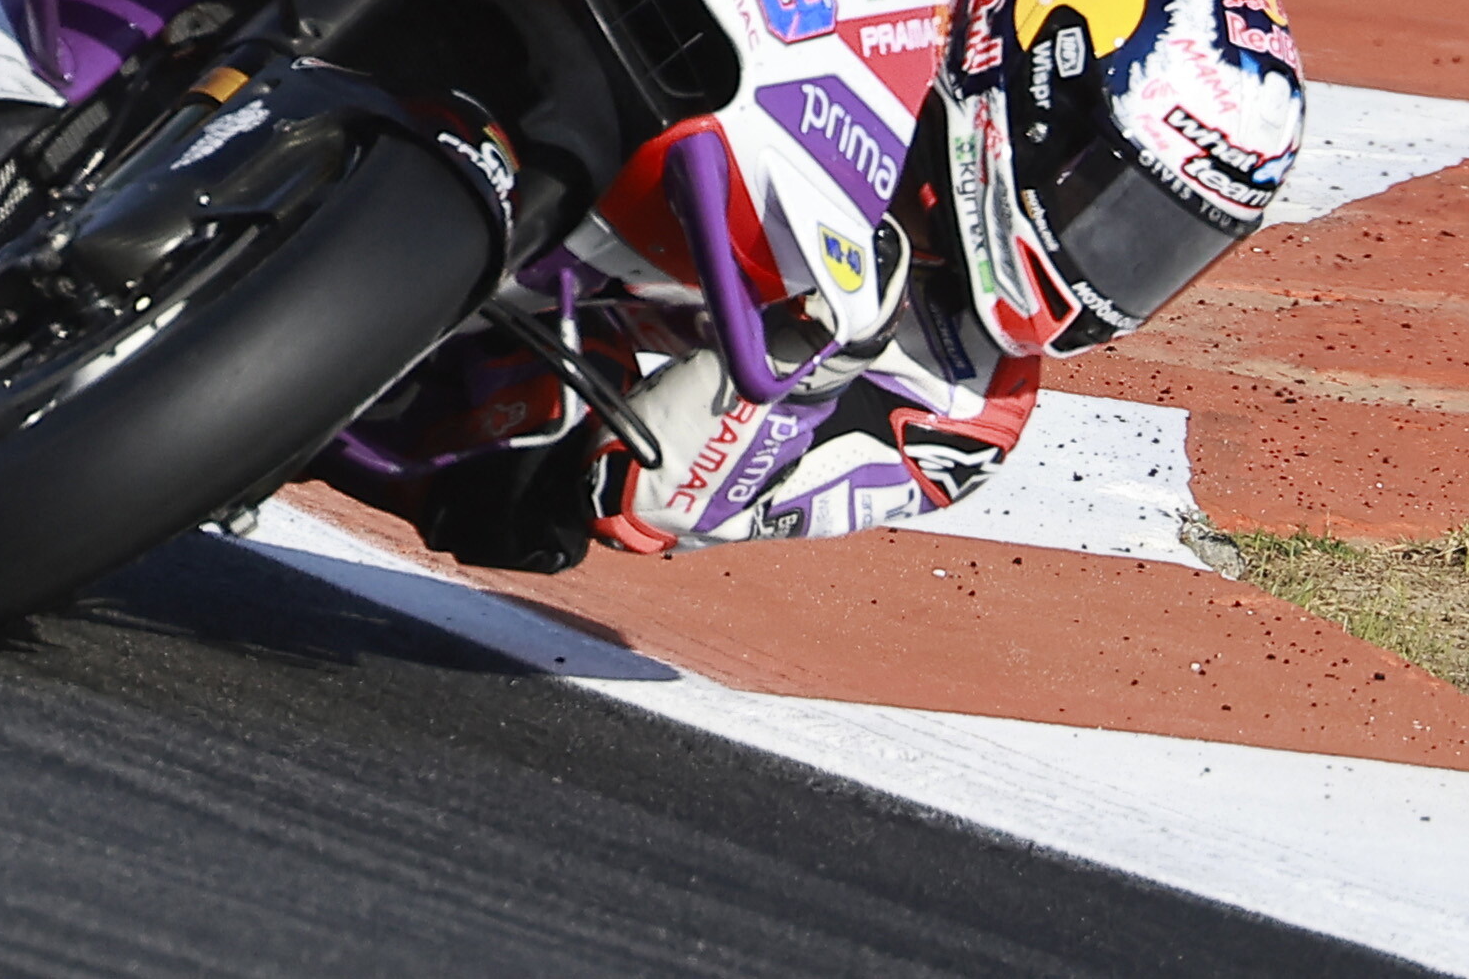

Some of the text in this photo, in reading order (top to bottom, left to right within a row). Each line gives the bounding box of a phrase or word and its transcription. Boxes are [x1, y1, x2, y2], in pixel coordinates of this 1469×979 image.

[801, 83, 899, 203] prima
[1168, 107, 1262, 172] what
[1184, 156, 1271, 209] team
[667, 392, 757, 513] RAMAC
[727, 412, 799, 503] prima
